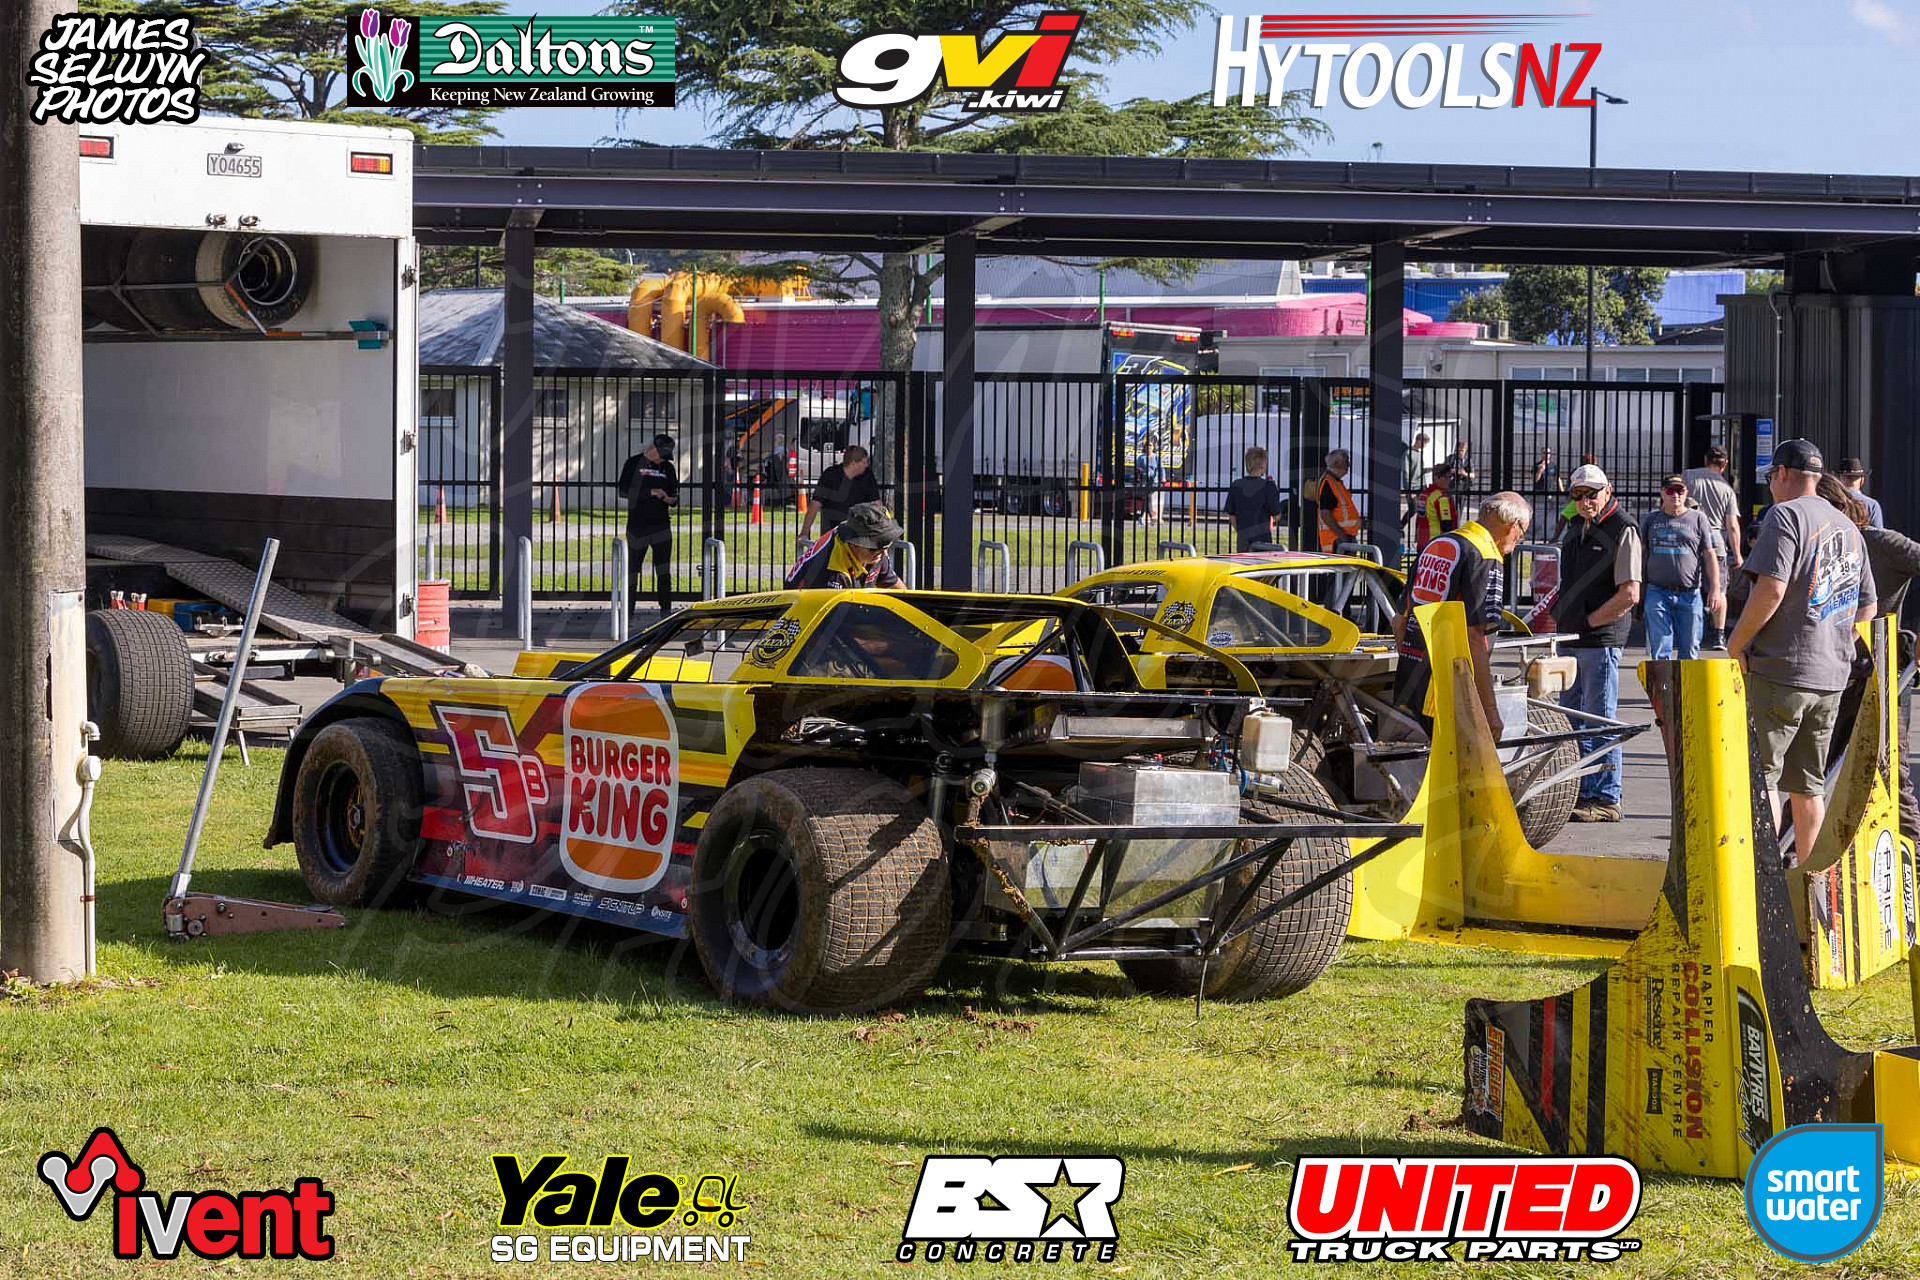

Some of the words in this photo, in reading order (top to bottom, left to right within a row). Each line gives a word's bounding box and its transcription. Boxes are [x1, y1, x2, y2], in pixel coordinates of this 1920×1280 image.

[569, 734, 672, 787] BURGER
[568, 776, 670, 846] KING
[1672, 963, 1682, 1041] REPAIR
[1702, 964, 1714, 1044] NAPIER
[1683, 962, 1704, 1140] COLLISION
[1747, 1024, 1767, 1121] BAYTYRES
[1672, 1054, 1683, 1139] CENTRE
